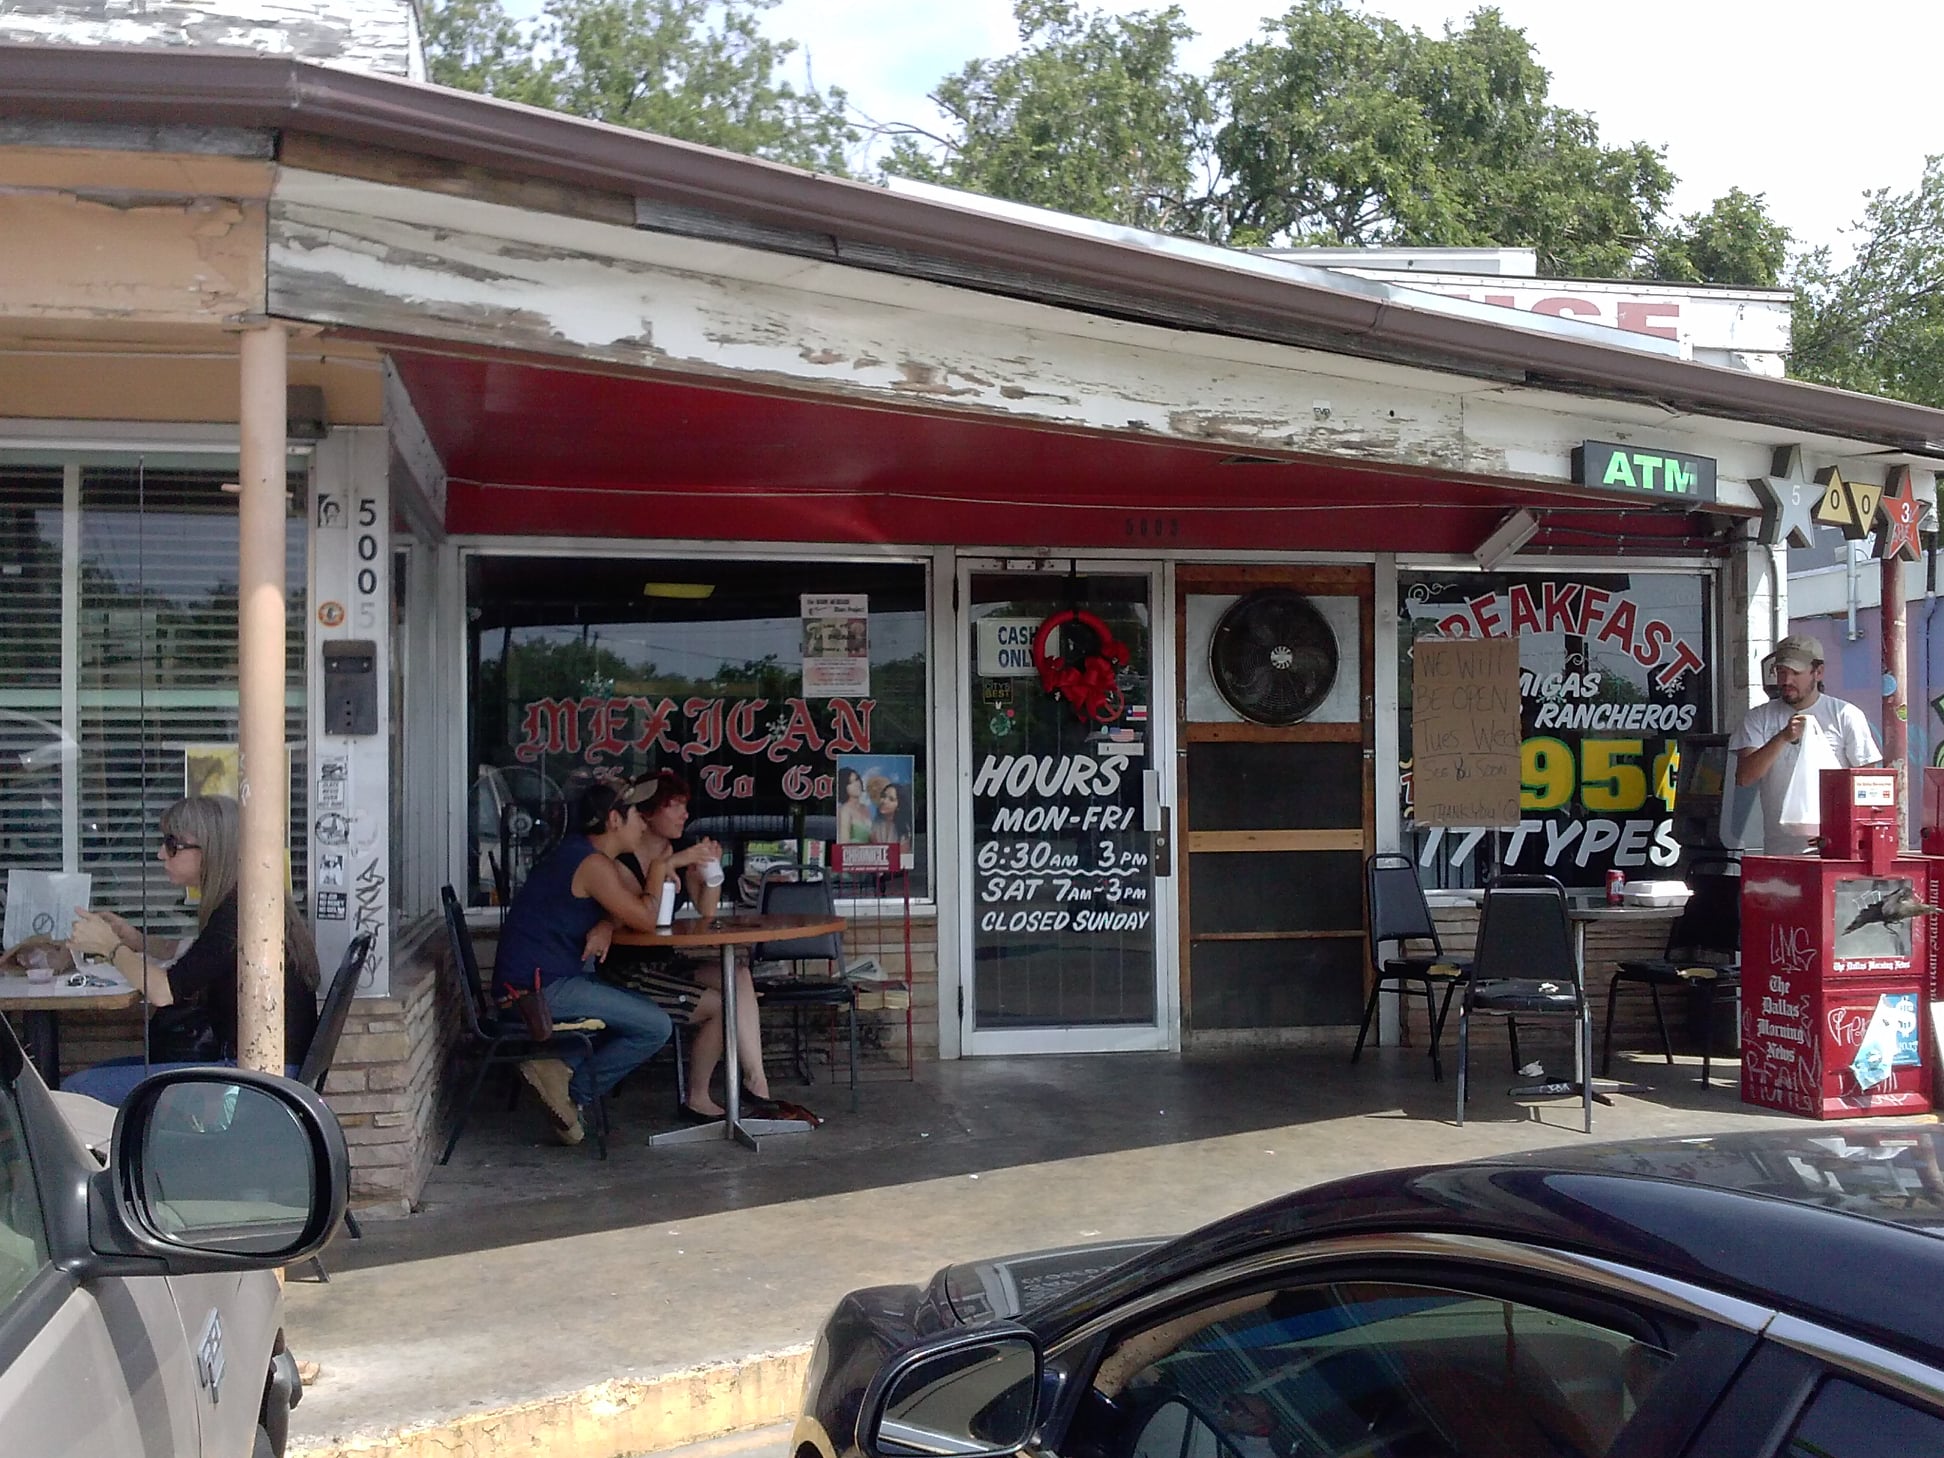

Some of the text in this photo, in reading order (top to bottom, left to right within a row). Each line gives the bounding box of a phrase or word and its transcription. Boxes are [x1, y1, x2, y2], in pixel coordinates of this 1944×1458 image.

[1603, 451, 1698, 495] ATM
[1416, 684, 1509, 713] BE OPEN
[514, 696, 876, 764] MEXICAN
[1534, 703, 1697, 731] RANCHEROS
[1413, 715, 1460, 752] Tues
[700, 763, 756, 800] To
[781, 763, 834, 800] Go
[973, 754, 1129, 797] HOURS
[991, 806, 1136, 833] MON-FRI
[1500, 818, 1682, 868] TYPES
[981, 877, 1044, 902] SAT
[981, 910, 1150, 932] CLOSED SUNDAY
[1769, 974, 1791, 997] The
[1762, 996, 1800, 1020] Dallas
[1756, 1018, 1806, 1045] Morning
[1766, 1041, 1797, 1064] News
